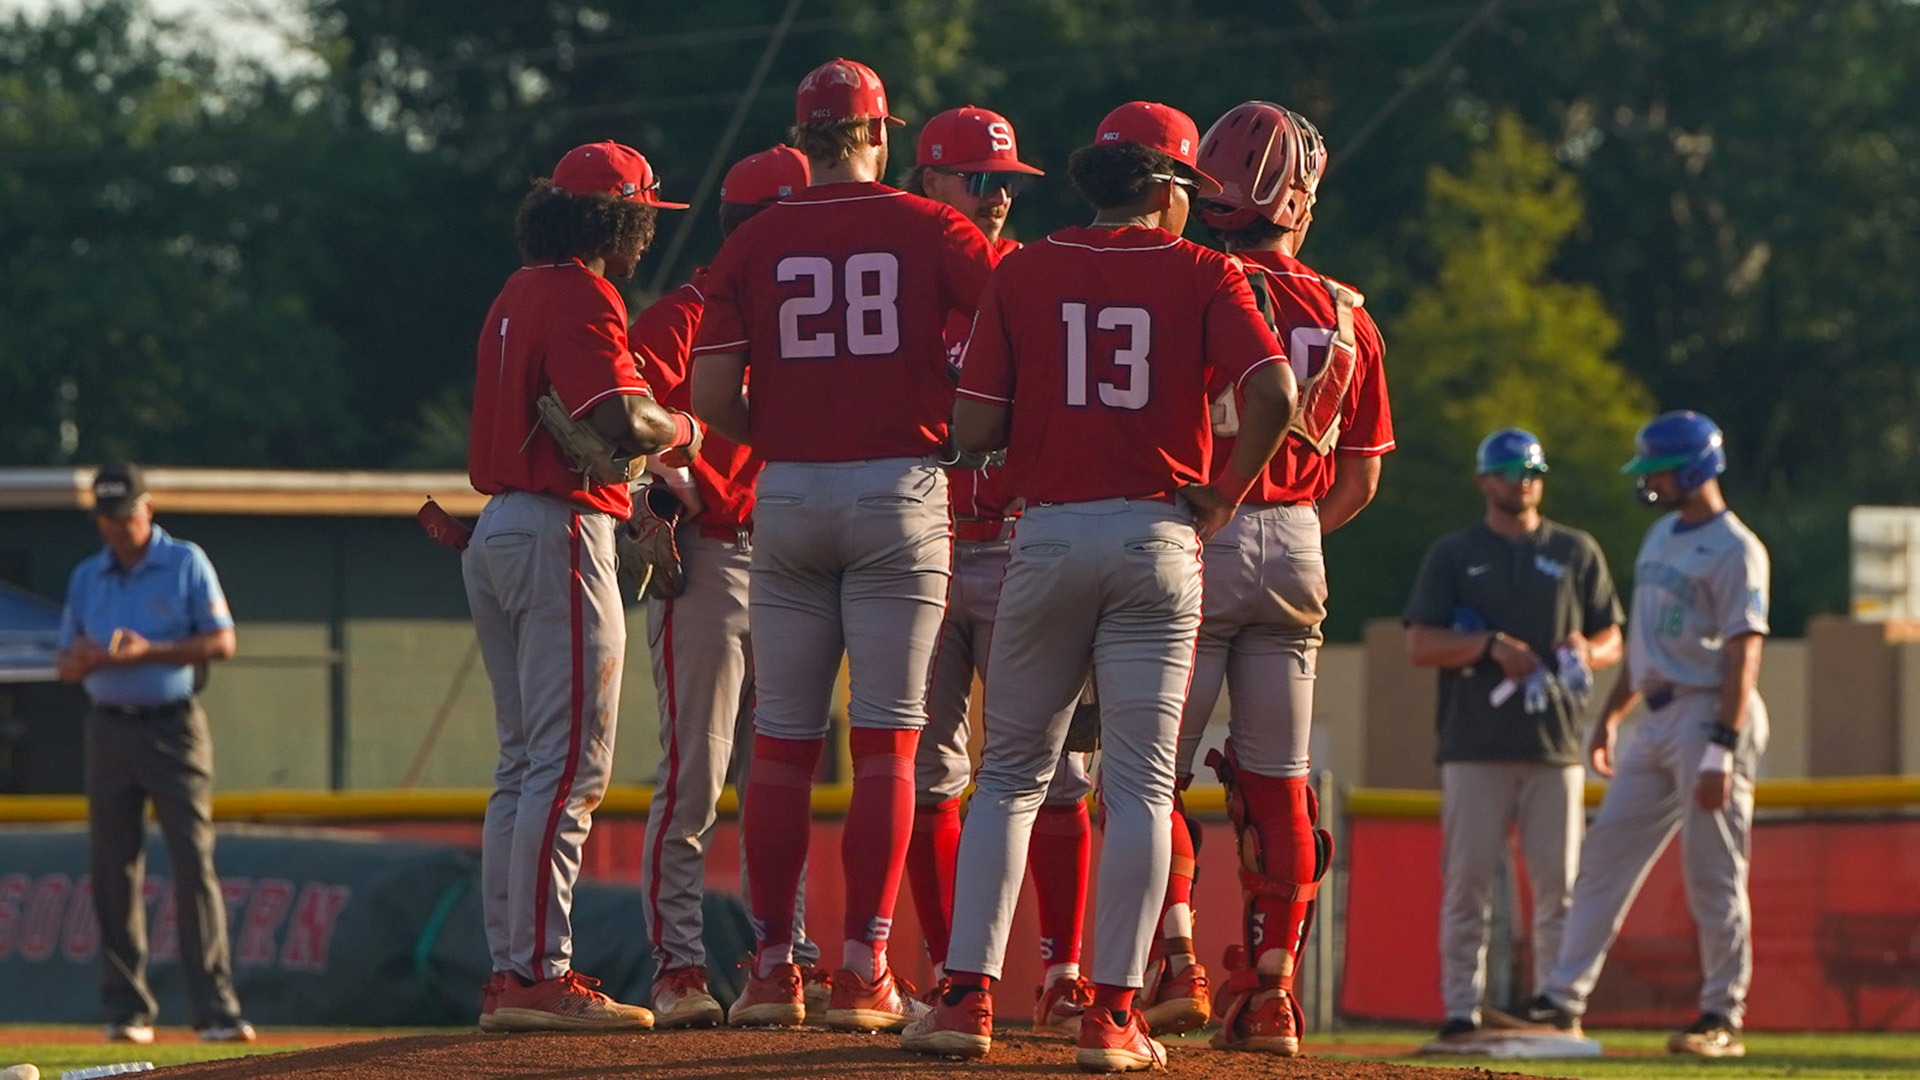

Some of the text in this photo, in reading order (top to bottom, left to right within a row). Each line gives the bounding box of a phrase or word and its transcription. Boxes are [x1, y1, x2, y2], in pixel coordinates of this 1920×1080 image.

[987, 122, 1013, 152] S
[776, 252, 900, 358] 28
[1061, 302, 1152, 410] 13
